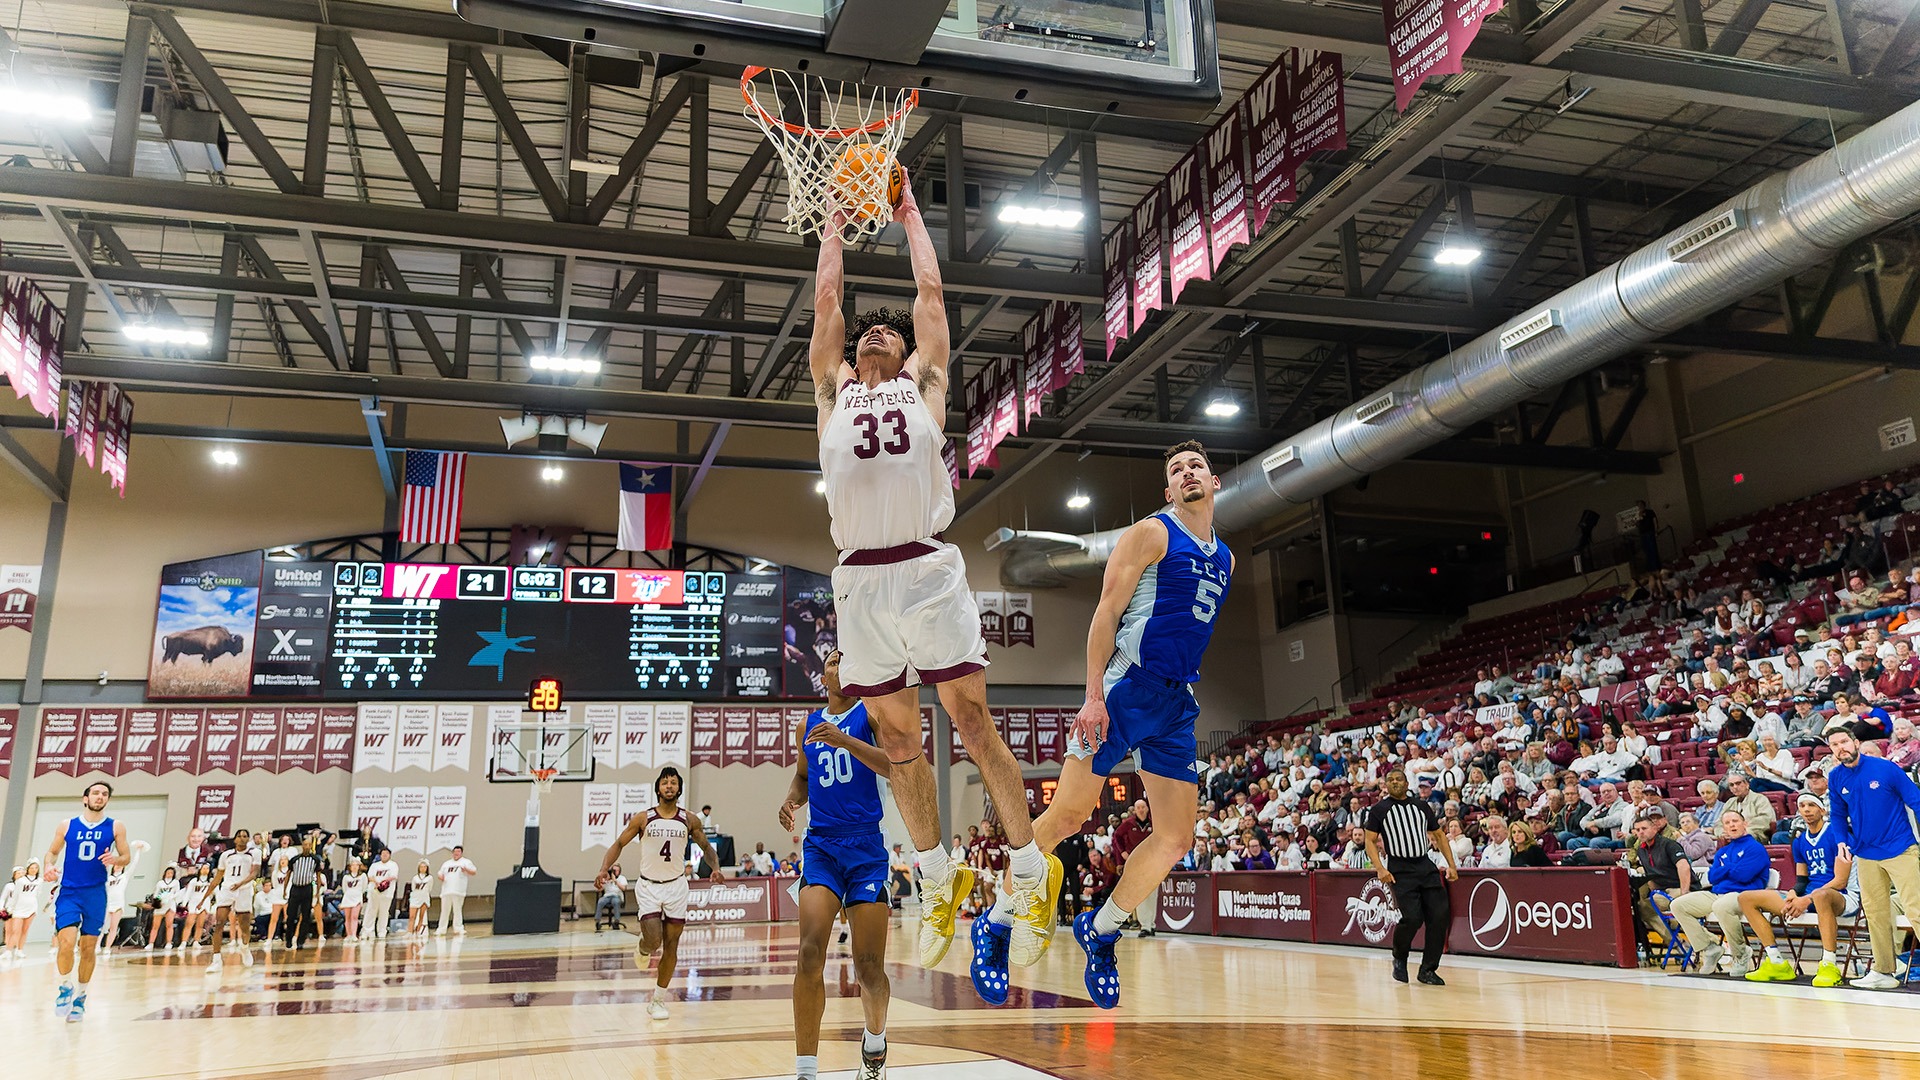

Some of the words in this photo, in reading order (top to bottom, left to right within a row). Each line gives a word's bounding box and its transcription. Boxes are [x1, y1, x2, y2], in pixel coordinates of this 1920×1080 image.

[1390, 22, 1411, 46] NCAA
[1397, 11, 1443, 57] SEMIFINALIST
[1298, 47, 1322, 75] W
[1396, 61, 1410, 76] LADY
[1300, 63, 1334, 100] CHAMPIONS
[1250, 65, 1281, 127] WT
[1292, 104, 1310, 123] NCAA
[1295, 95, 1337, 133] SEMIFINALIST
[1261, 117, 1281, 145] NCAA
[1208, 112, 1236, 169] WT
[1290, 137, 1302, 149] LADY
[1169, 154, 1195, 207] WT
[1217, 160, 1234, 184] NCAA
[1213, 170, 1242, 207] REGIONAL
[1212, 186, 1244, 224] SEMIFINALIST
[1136, 190, 1159, 239] WT
[1104, 225, 1125, 272] WT
[844, 394, 876, 410] WEST
[877, 389, 916, 406] TEXAS
[853, 408, 911, 460] 33
[275, 568, 323, 581] United
[338, 568, 353, 583] 4
[364, 568, 379, 584] 2
[392, 565, 450, 598] WT
[466, 574, 495, 592] 21
[518, 572, 556, 587] 6:02
[578, 576, 607, 594] 12
[708, 578, 721, 592] 4
[4, 593, 28, 612] 14
[1192, 579, 1223, 624] 5
[982, 615, 1000, 630] 44
[1013, 616, 1027, 631] 10
[741, 668, 768, 678] BUD
[736, 677, 772, 687] LIGHT
[532, 688, 559, 710] 28
[1485, 704, 1516, 721] TRADIT
[42, 735, 76, 753] WT
[84, 735, 117, 753] WT
[126, 735, 158, 753] WT
[166, 735, 198, 752] WT
[206, 734, 237, 752] WT
[246, 734, 277, 751] WT
[285, 733, 315, 751] WT
[323, 733, 352, 750] WT
[364, 733, 389, 747] WT
[403, 733, 428, 747] WT
[441, 733, 466, 746] WT
[625, 732, 647, 745] WT
[660, 731, 682, 744] WT
[694, 731, 718, 747] WT
[726, 731, 750, 747] WT
[757, 731, 780, 747] WT
[1009, 731, 1030, 745] WT
[1037, 731, 1058, 745] WT
[817, 747, 854, 788] 30
[198, 814, 229, 832] WT
[396, 816, 421, 830] WT
[434, 814, 459, 828] WT
[588, 812, 611, 826] WT
[76, 830, 102, 840] LCU
[647, 829, 664, 838] WEST
[666, 829, 686, 838] TEXAS
[78, 841, 97, 861] 0
[659, 840, 672, 862] 4
[1806, 848, 1825, 860] LCU
[231, 865, 242, 877] 11
[521, 866, 539, 879] WT
[711, 885, 763, 903] Fincher
[1176, 878, 1196, 894] smile
[1162, 895, 1195, 907] DENTAL
[1233, 890, 1277, 904] Northwest
[1277, 891, 1301, 906] Texas
[715, 908, 746, 921] SHOP
[1233, 904, 1277, 919] Healthcare
[1279, 906, 1311, 922] System
[1514, 895, 1592, 936] pepsi
